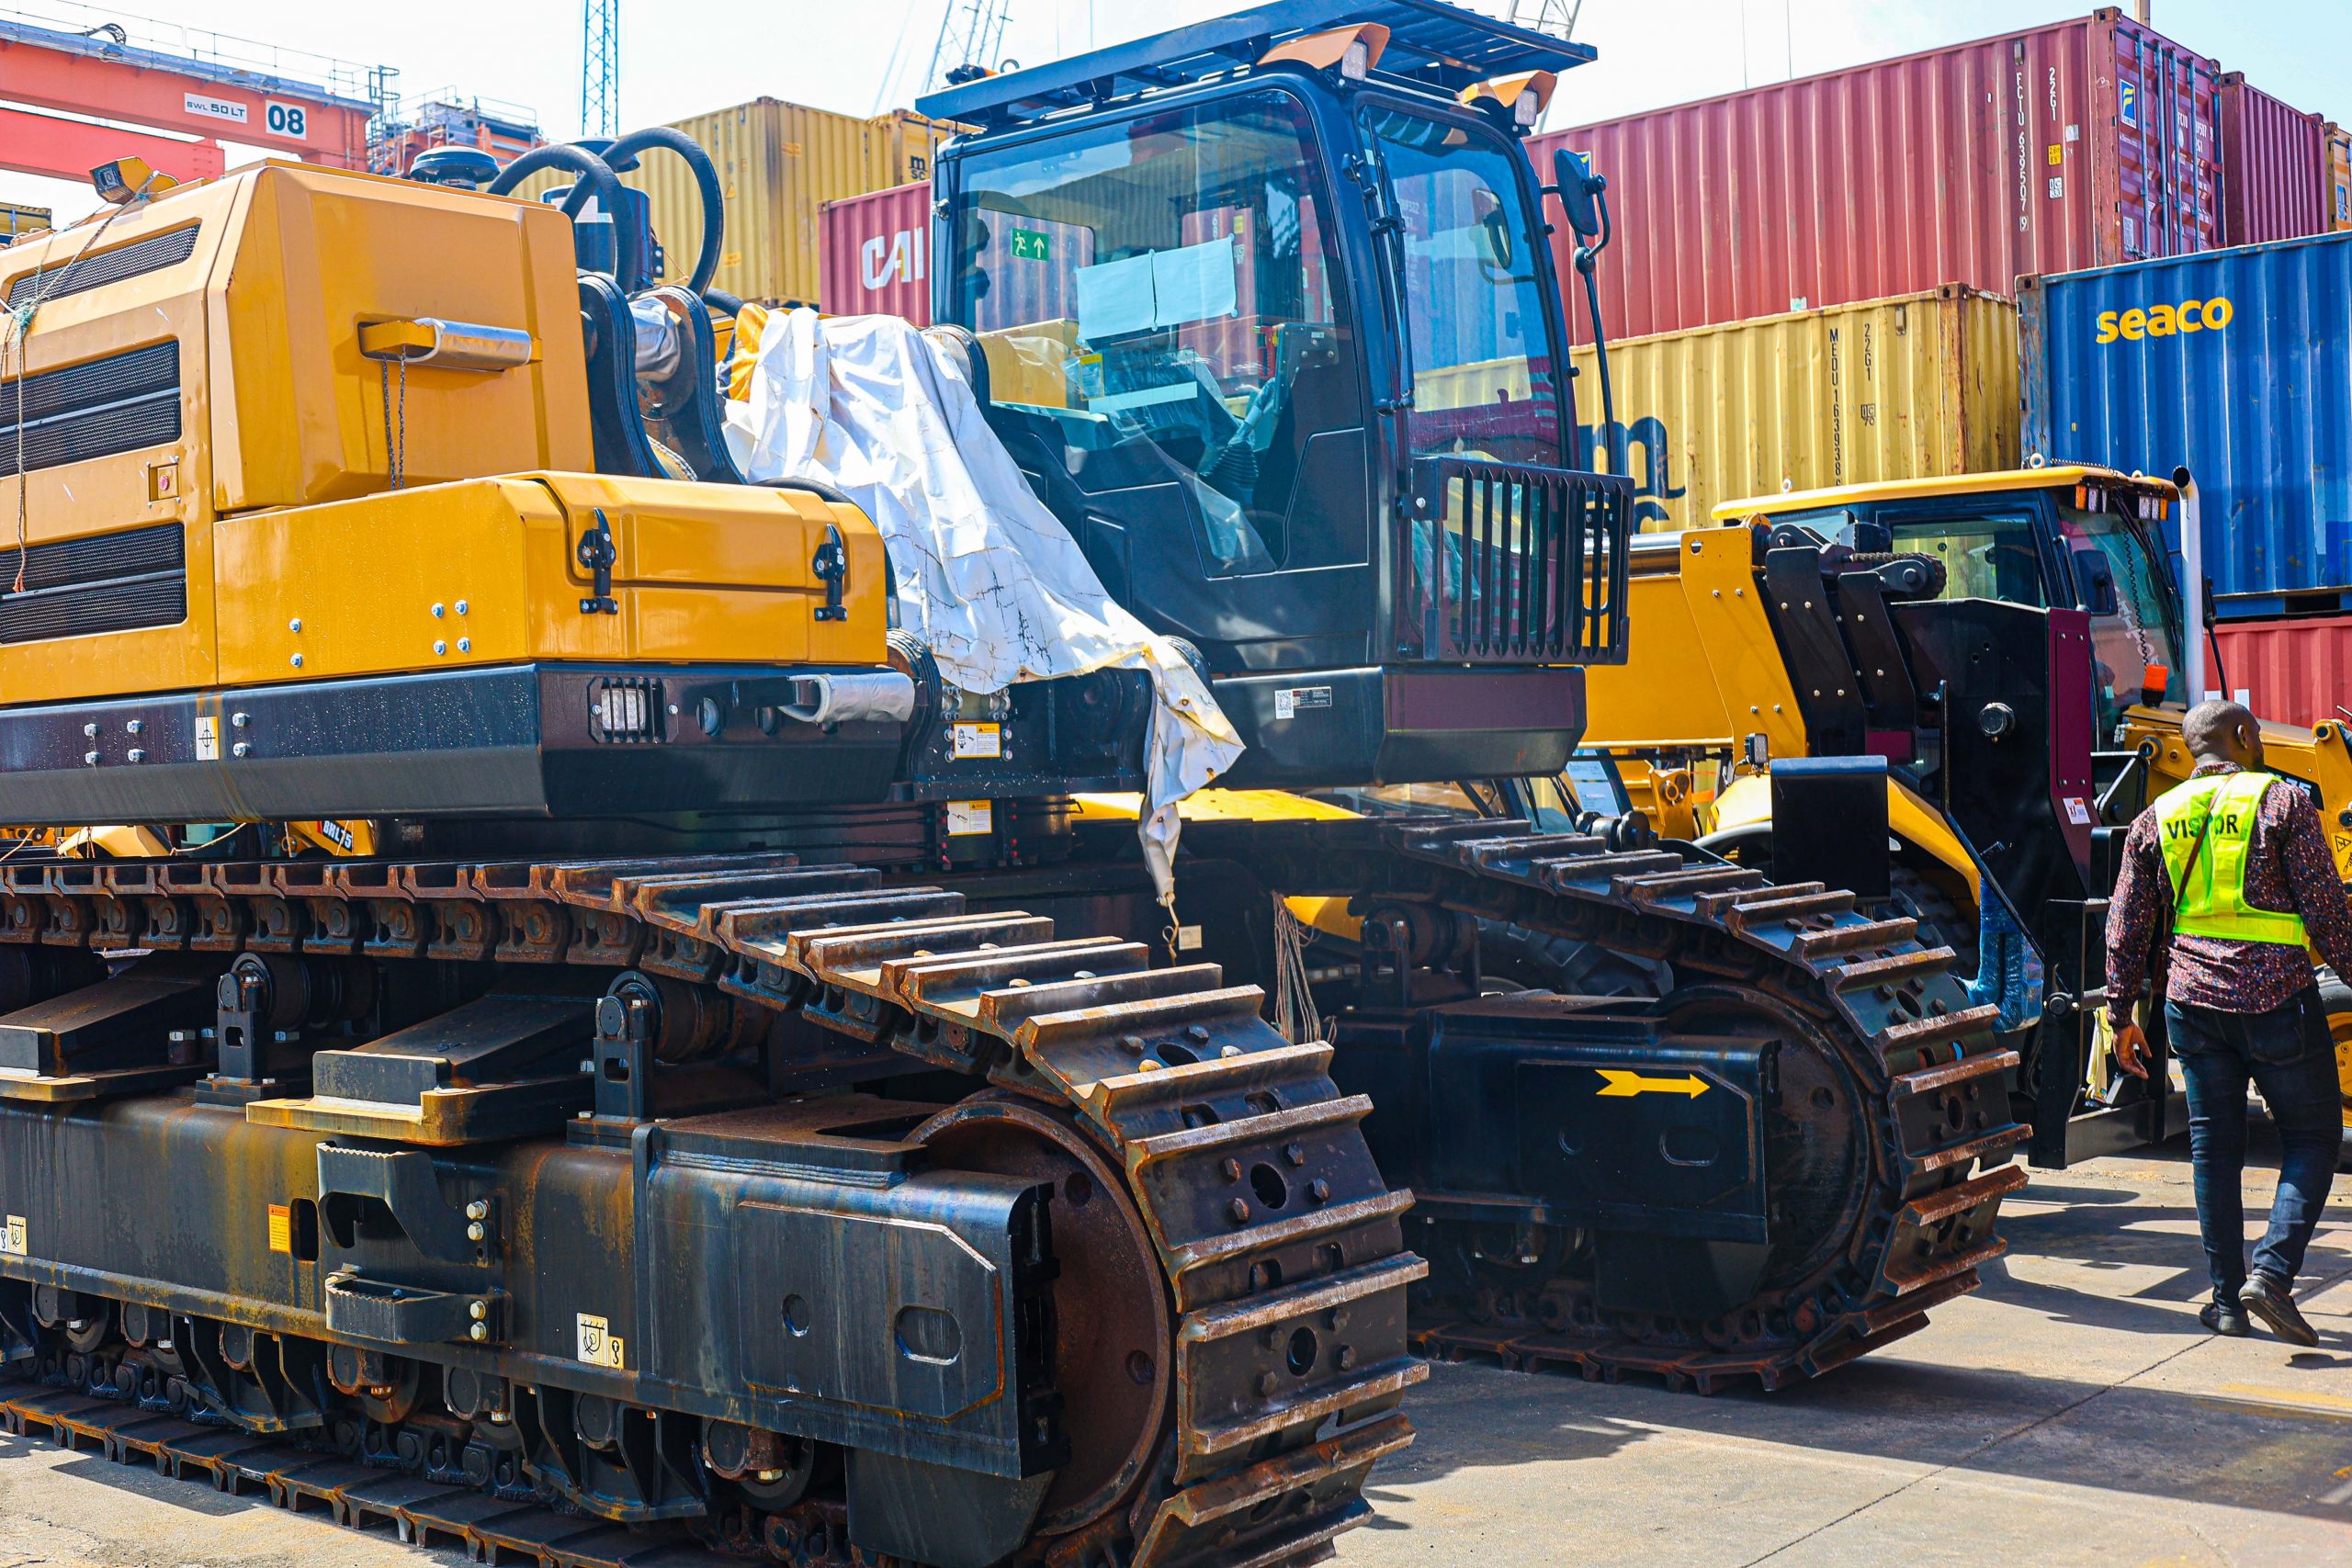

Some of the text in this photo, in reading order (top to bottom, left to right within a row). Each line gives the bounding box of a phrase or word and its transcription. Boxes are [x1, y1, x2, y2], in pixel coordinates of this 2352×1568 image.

[187, 101, 209, 110] SWL
[2016, 72, 2025, 127] FCIU
[2049, 66, 2057, 121] 22G1
[267, 105, 305, 135] 08
[861, 226, 924, 290] CAI
[2096, 297, 2233, 344] seaco
[1829, 328, 1838, 386] MEDU
[2165, 814, 2239, 840] VISOR
